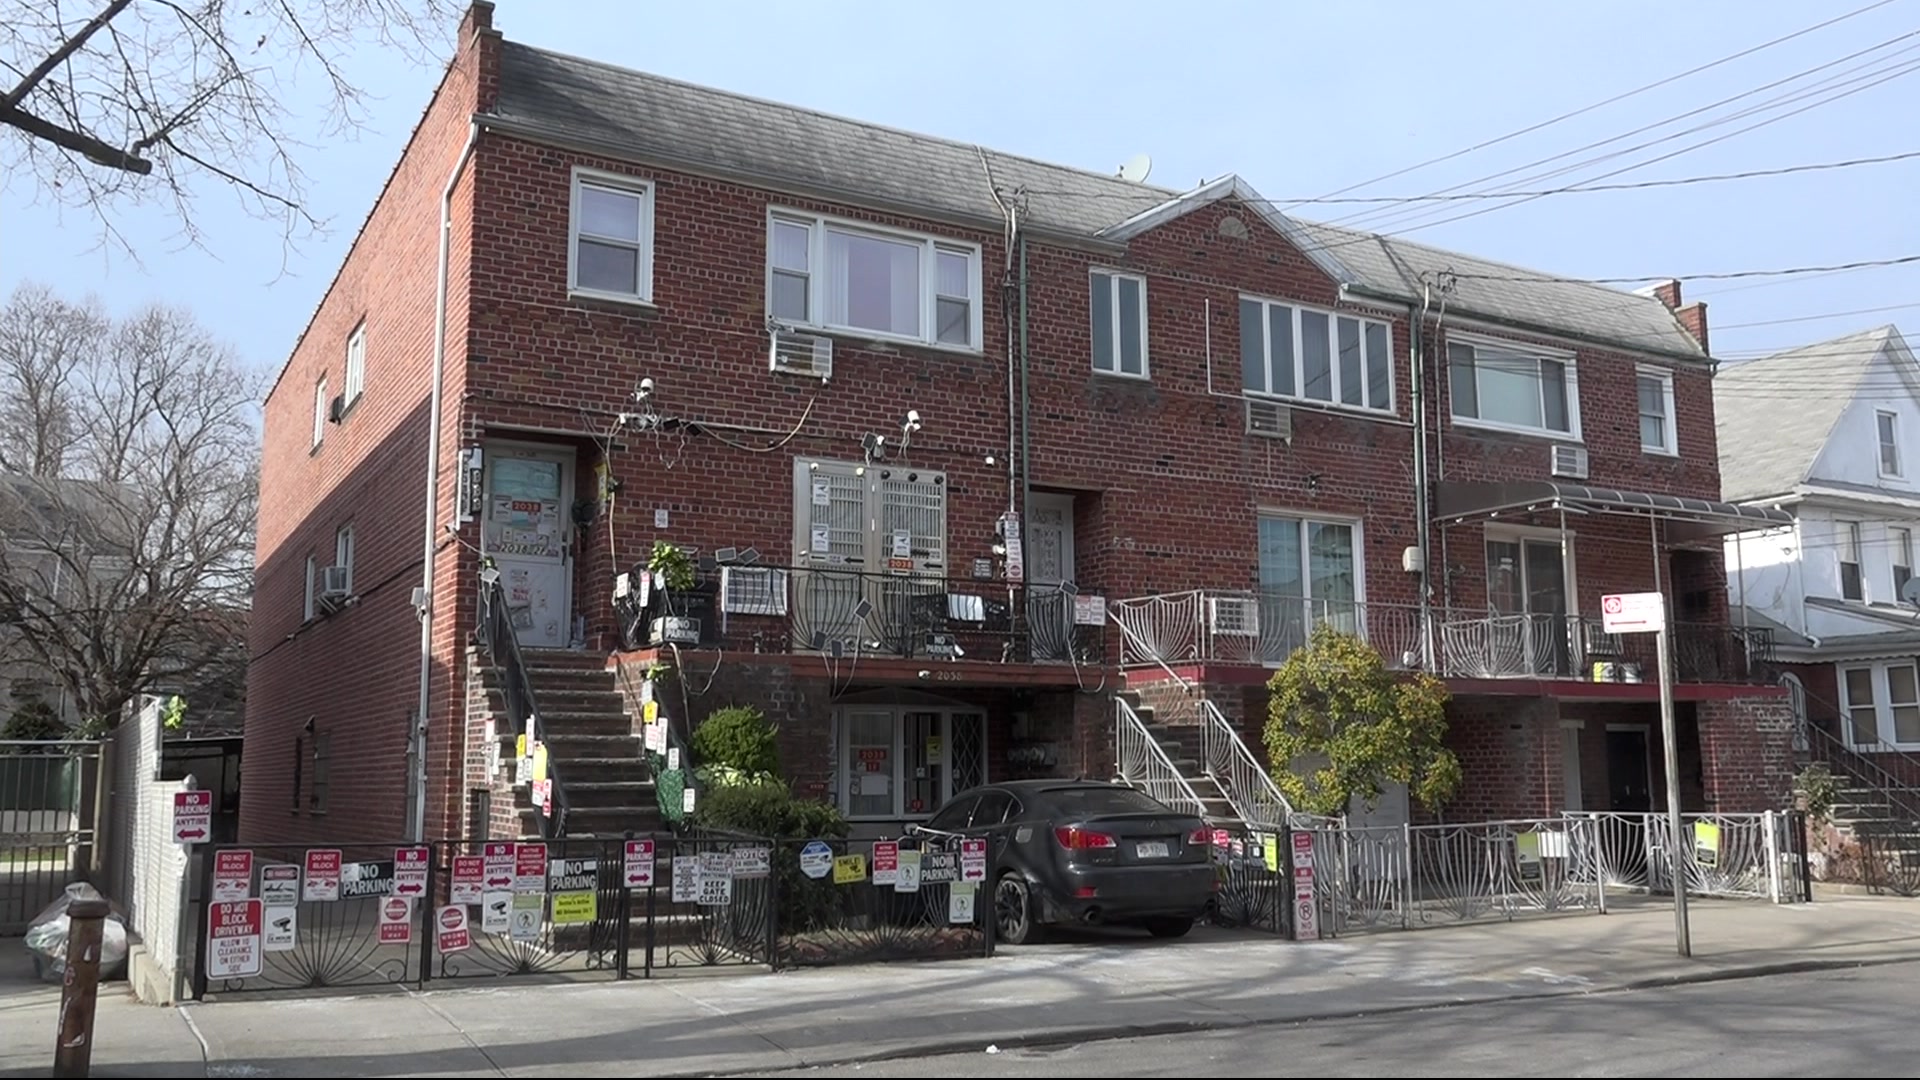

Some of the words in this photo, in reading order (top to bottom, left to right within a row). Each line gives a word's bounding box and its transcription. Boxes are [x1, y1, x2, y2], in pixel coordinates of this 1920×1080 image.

[186, 794, 200, 805] NO
[175, 804, 210, 814] PARKING
[176, 818, 208, 826] ANYTIME
[494, 846, 506, 854] NO
[634, 844, 645, 852] NO
[969, 843, 978, 851] NO
[406, 851, 418, 860] NO
[222, 862, 246, 870] BLOCK
[396, 861, 426, 870] PARKING
[932, 856, 946, 868] NO
[360, 864, 379, 879] NO
[486, 866, 512, 874] ANYTIME
[566, 862, 582, 875] NO
[921, 868, 958, 882] PARKING
[344, 878, 394, 896] PARKING
[551, 874, 596, 891] PARKING
[220, 904, 232, 914] DO
[233, 902, 249, 913] NOT
[222, 914, 248, 925] BLOCK
[214, 924, 254, 937] DRIVEWAY
[442, 932, 466, 940] WRONG
[220, 939, 240, 947] ALLOW
[217, 946, 252, 956] CLEARANCE
[219, 957, 228, 966] ON
[230, 955, 250, 964] EITHER
